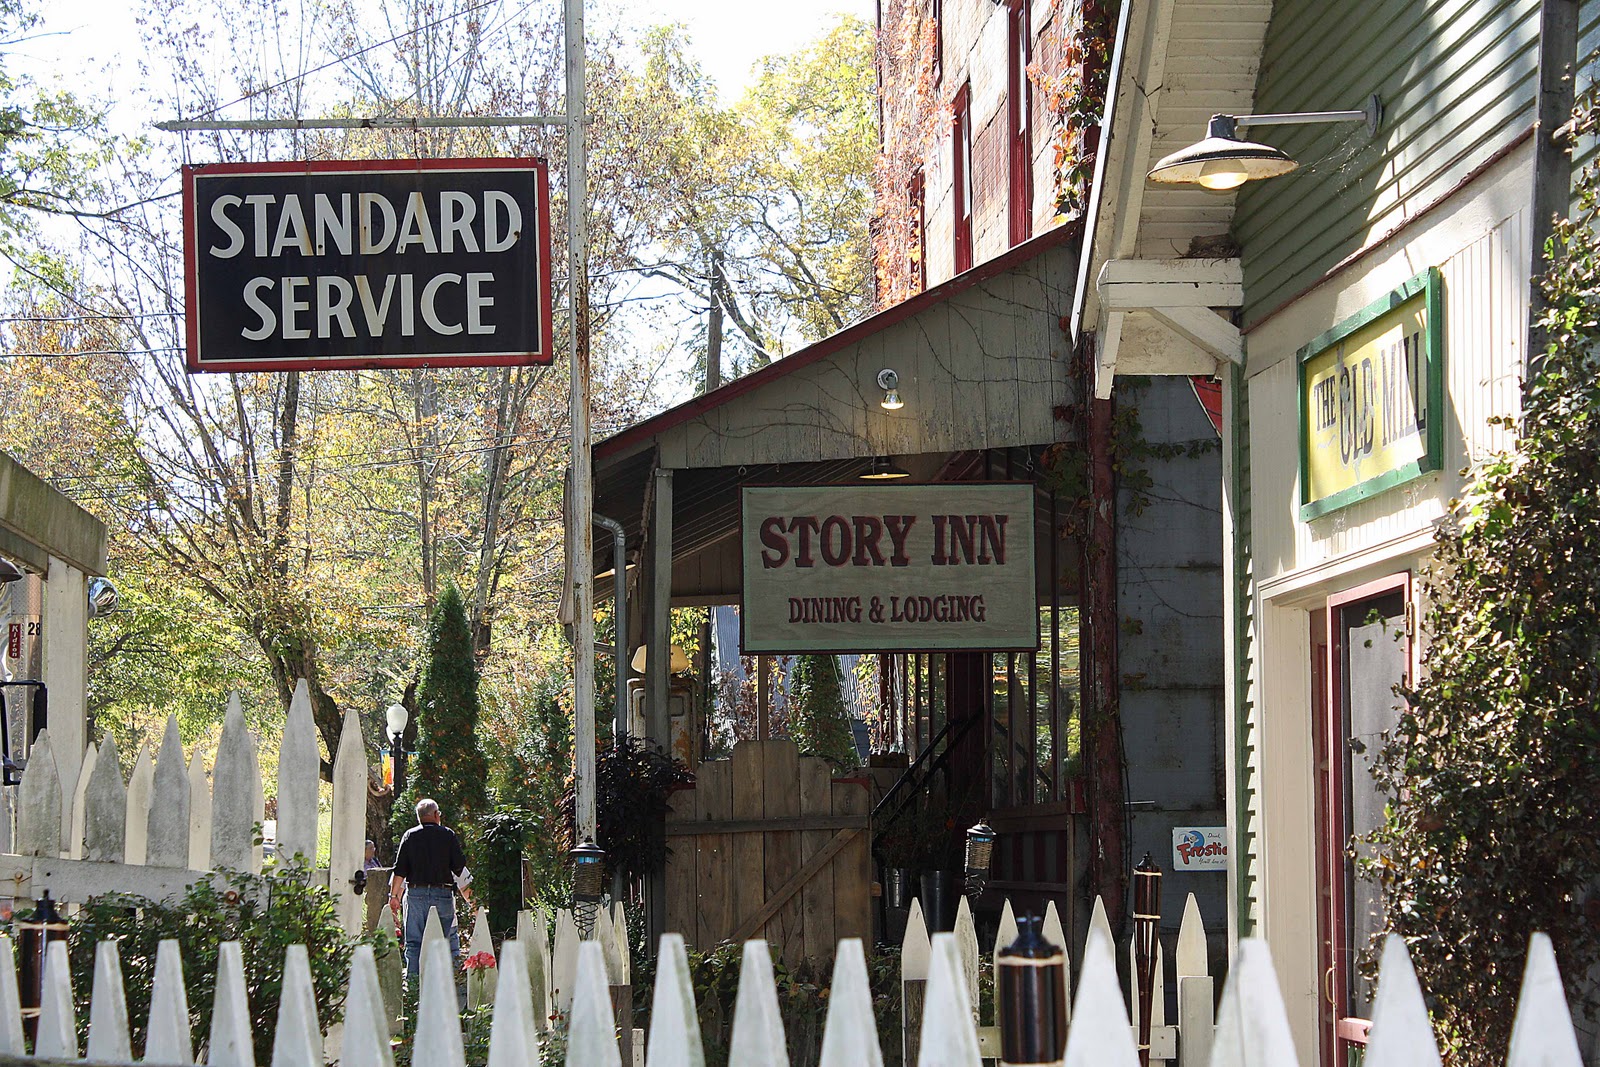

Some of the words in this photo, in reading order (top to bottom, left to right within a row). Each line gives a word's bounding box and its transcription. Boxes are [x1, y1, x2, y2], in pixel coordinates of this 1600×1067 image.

[209, 190, 523, 259] STANDARD
[240, 271, 497, 341] SERVICE
[1313, 374, 1337, 432] THE
[1339, 356, 1375, 466] OLD
[1380, 331, 1426, 447] MILL
[759, 514, 917, 569] STORY
[931, 514, 1009, 565] INN
[28, 622, 40, 636] 28
[788, 595, 863, 624] DINING
[868, 595, 886, 624] &
[890, 594, 987, 623] LODGING
